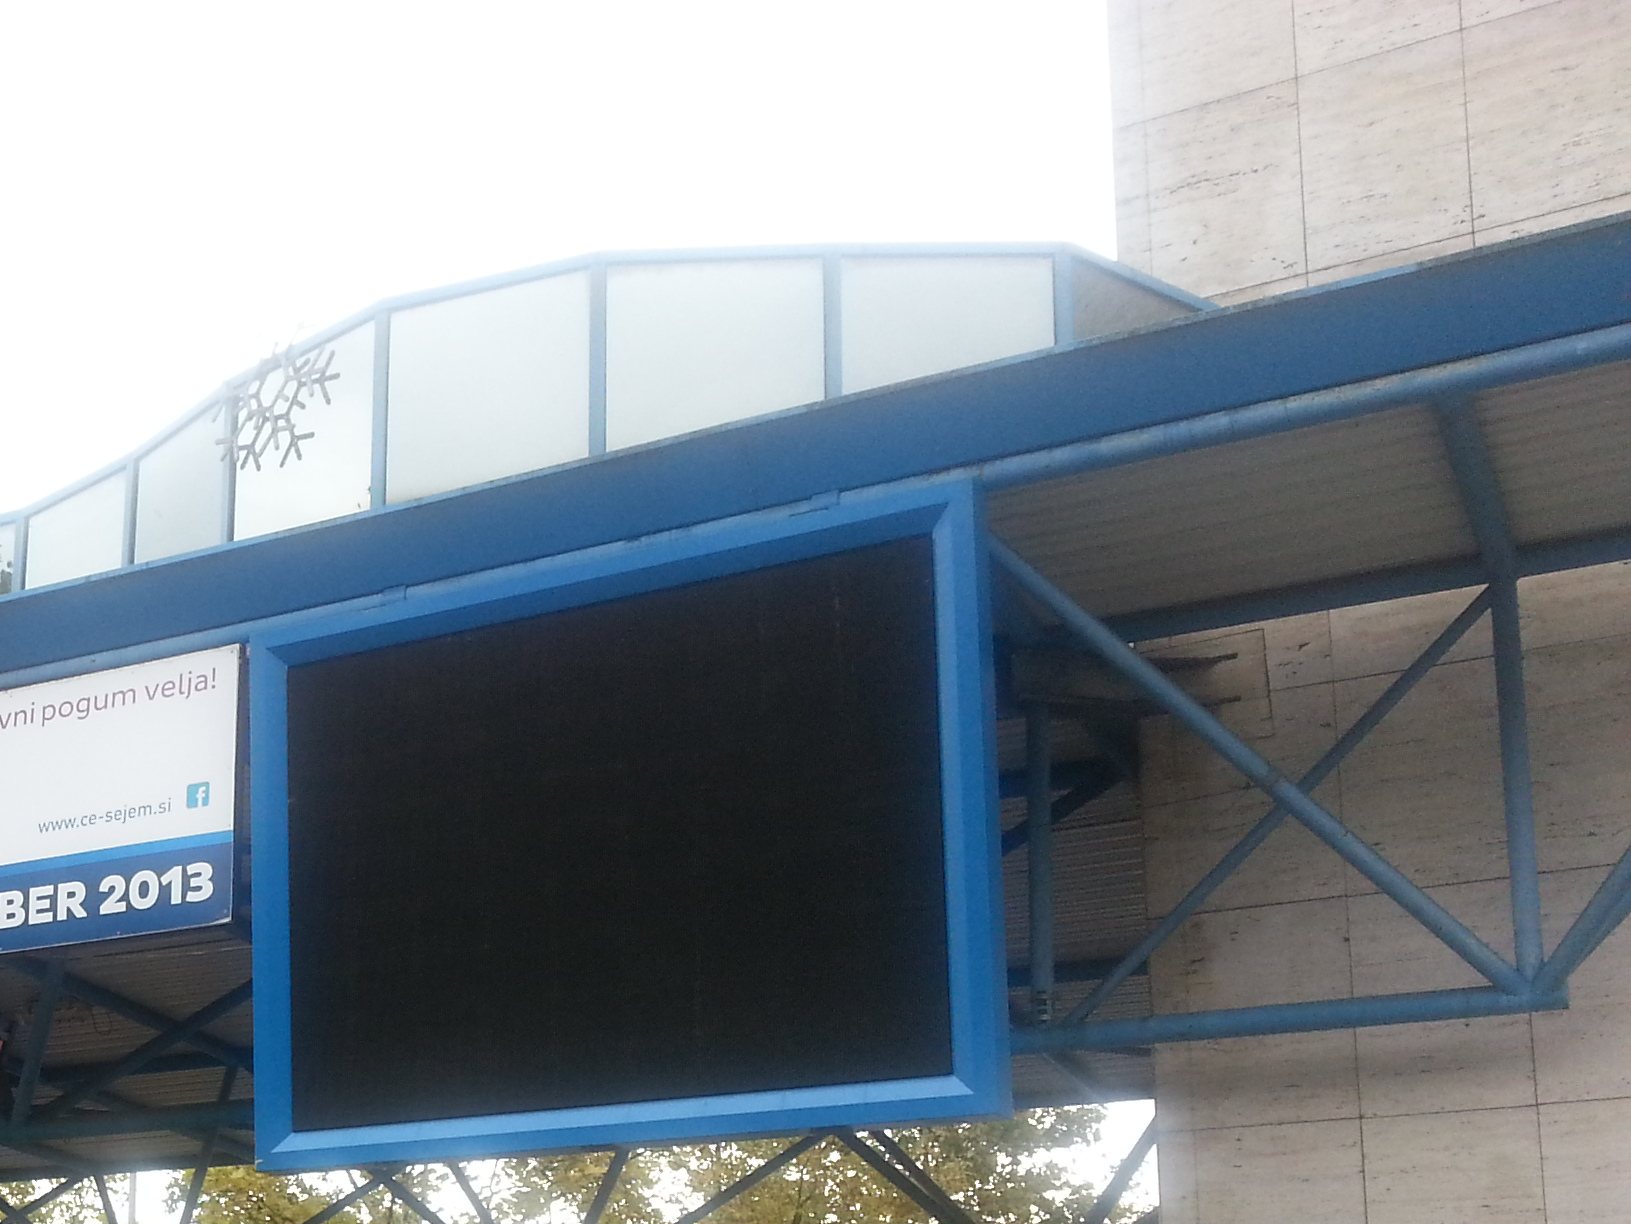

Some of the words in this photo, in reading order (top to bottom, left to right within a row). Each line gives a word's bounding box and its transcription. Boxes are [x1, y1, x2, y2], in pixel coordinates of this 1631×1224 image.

[40, 682, 137, 728] pogum
[144, 667, 218, 704] velja!
[37, 797, 172, 834] www.ce-sejem.si
[98, 861, 214, 916] 2013
